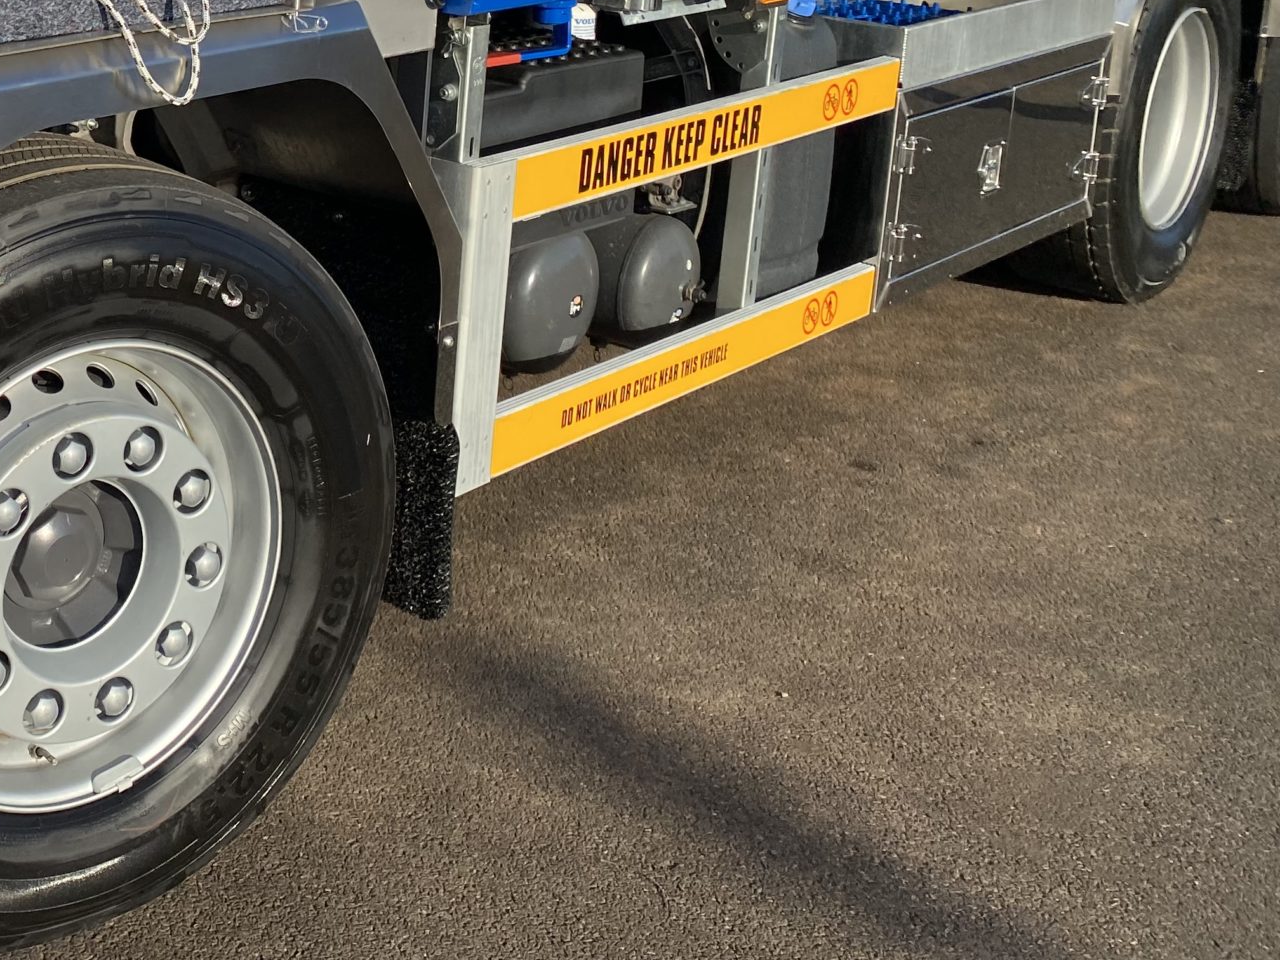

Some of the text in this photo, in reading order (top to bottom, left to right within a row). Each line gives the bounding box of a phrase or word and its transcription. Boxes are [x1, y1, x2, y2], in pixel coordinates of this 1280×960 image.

[578, 104, 762, 194] DANGER KEEP CLEAR
[560, 194, 629, 227] VOLVO
[41, 253, 187, 309] Hybrid
[561, 343, 729, 429] DO NOT WALK OR CYCLE NEAR THIS VEHICLE
[217, 706, 254, 747] M+S
